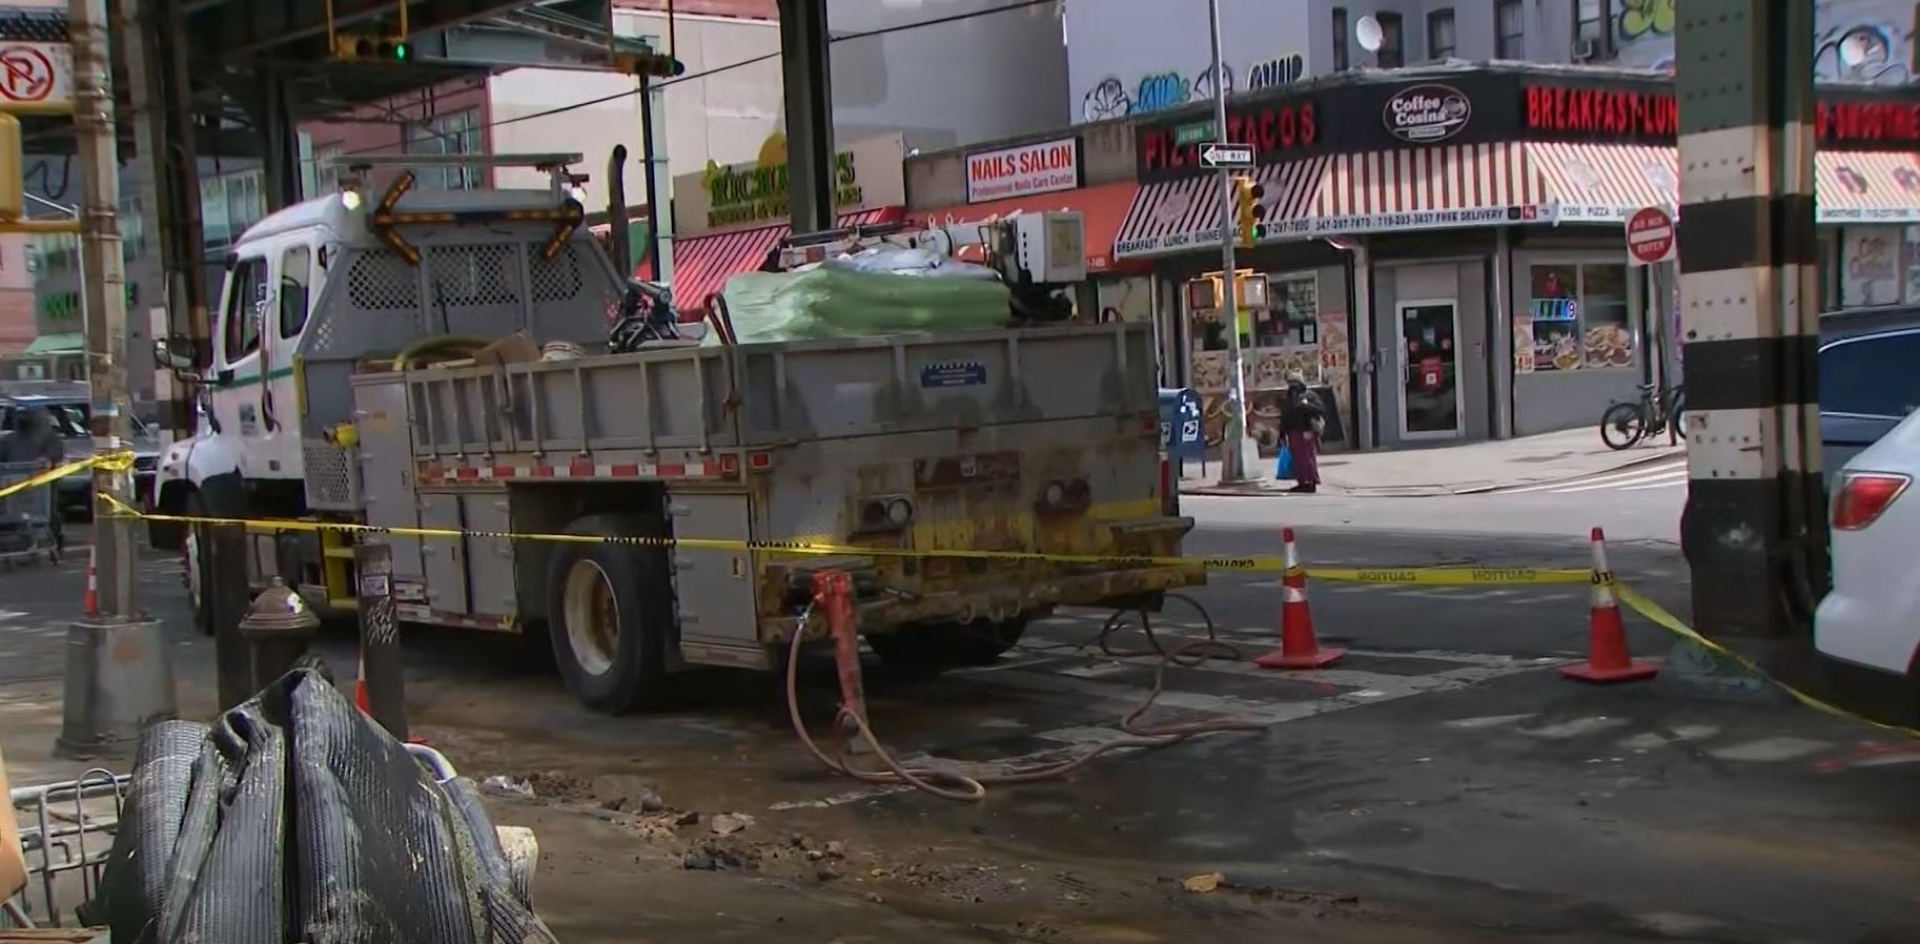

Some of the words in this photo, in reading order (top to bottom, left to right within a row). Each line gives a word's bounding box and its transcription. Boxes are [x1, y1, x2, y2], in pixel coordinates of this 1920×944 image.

[1392, 95, 1440, 113] Coffee
[1527, 83, 1639, 133] BREAKFAST
[1643, 92, 1679, 135] LUN
[1395, 109, 1446, 126] Cosina
[1228, 103, 1317, 152] TACOS
[972, 154, 1016, 181] NAILS
[1019, 145, 1072, 174] SALON
[1230, 150, 1247, 161] WAY
[1460, 208, 1504, 221] DELIVERY
[1116, 239, 1158, 254] BREAKFAST
[1164, 235, 1189, 247] LUNCH
